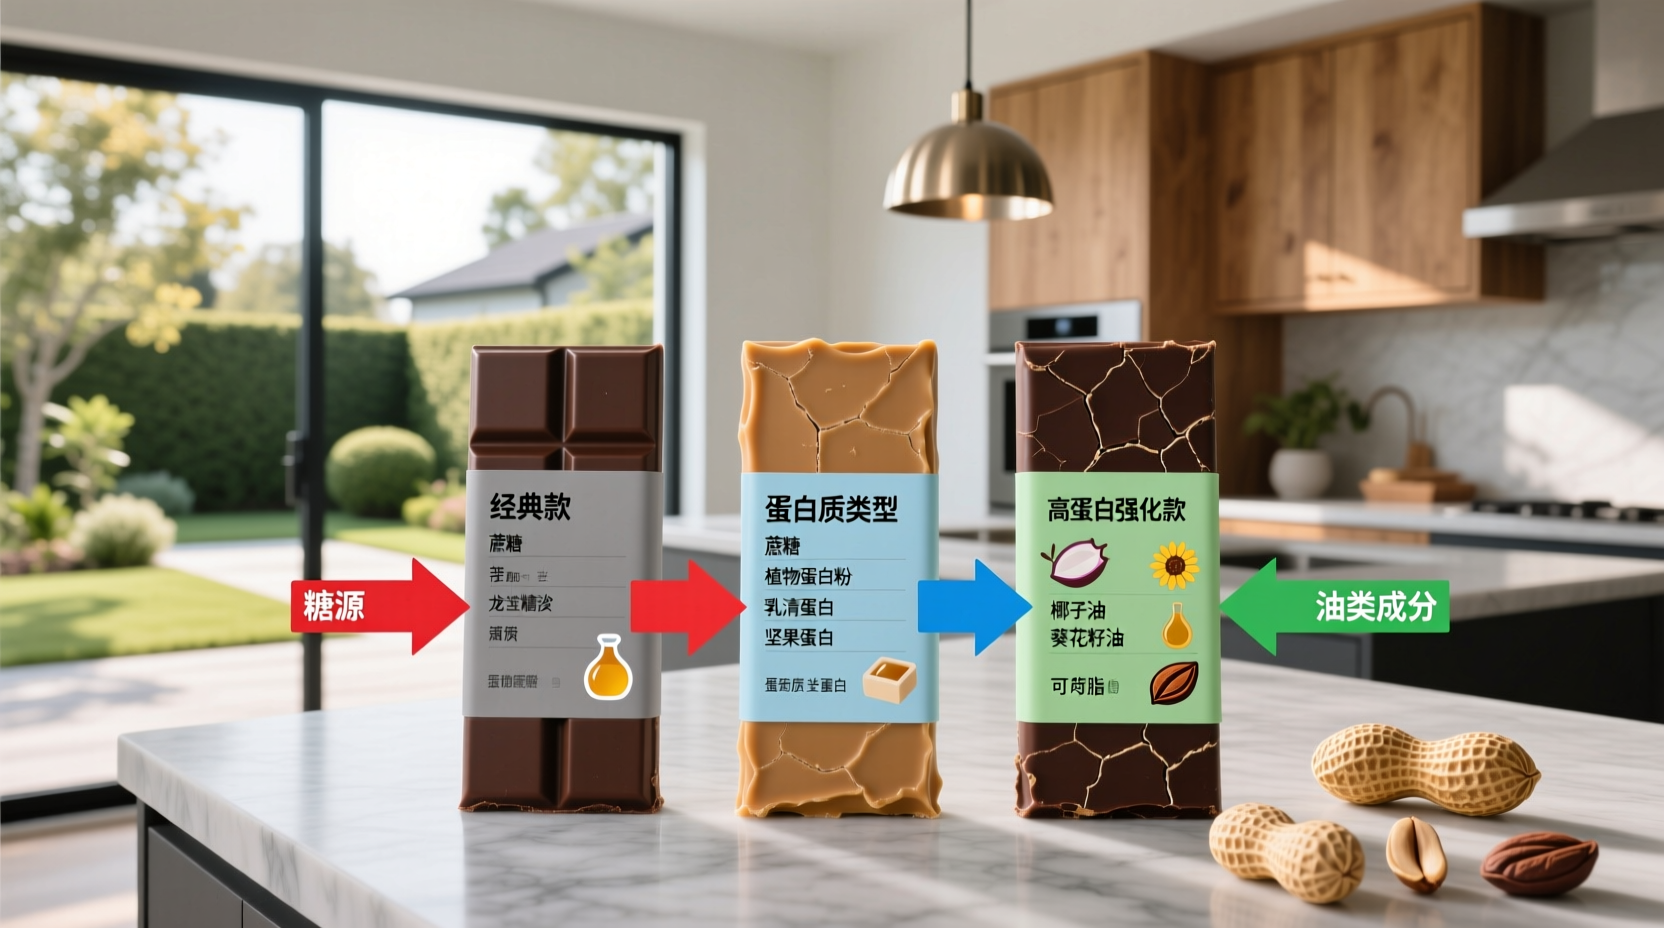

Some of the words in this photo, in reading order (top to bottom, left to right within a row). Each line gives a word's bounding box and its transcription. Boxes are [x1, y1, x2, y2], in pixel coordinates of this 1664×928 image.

[490, 491, 572, 522] 经典款
[764, 494, 899, 524] 蛋白质类型
[1047, 496, 1187, 523] 高蛋白强化款
[764, 567, 853, 587] 植物蛋白粉
[764, 597, 834, 617] 乳清蛋白
[1050, 600, 1106, 621] 椰子油
[764, 628, 834, 648] 坚果蛋白
[1050, 627, 1125, 649] 葵花籽油
